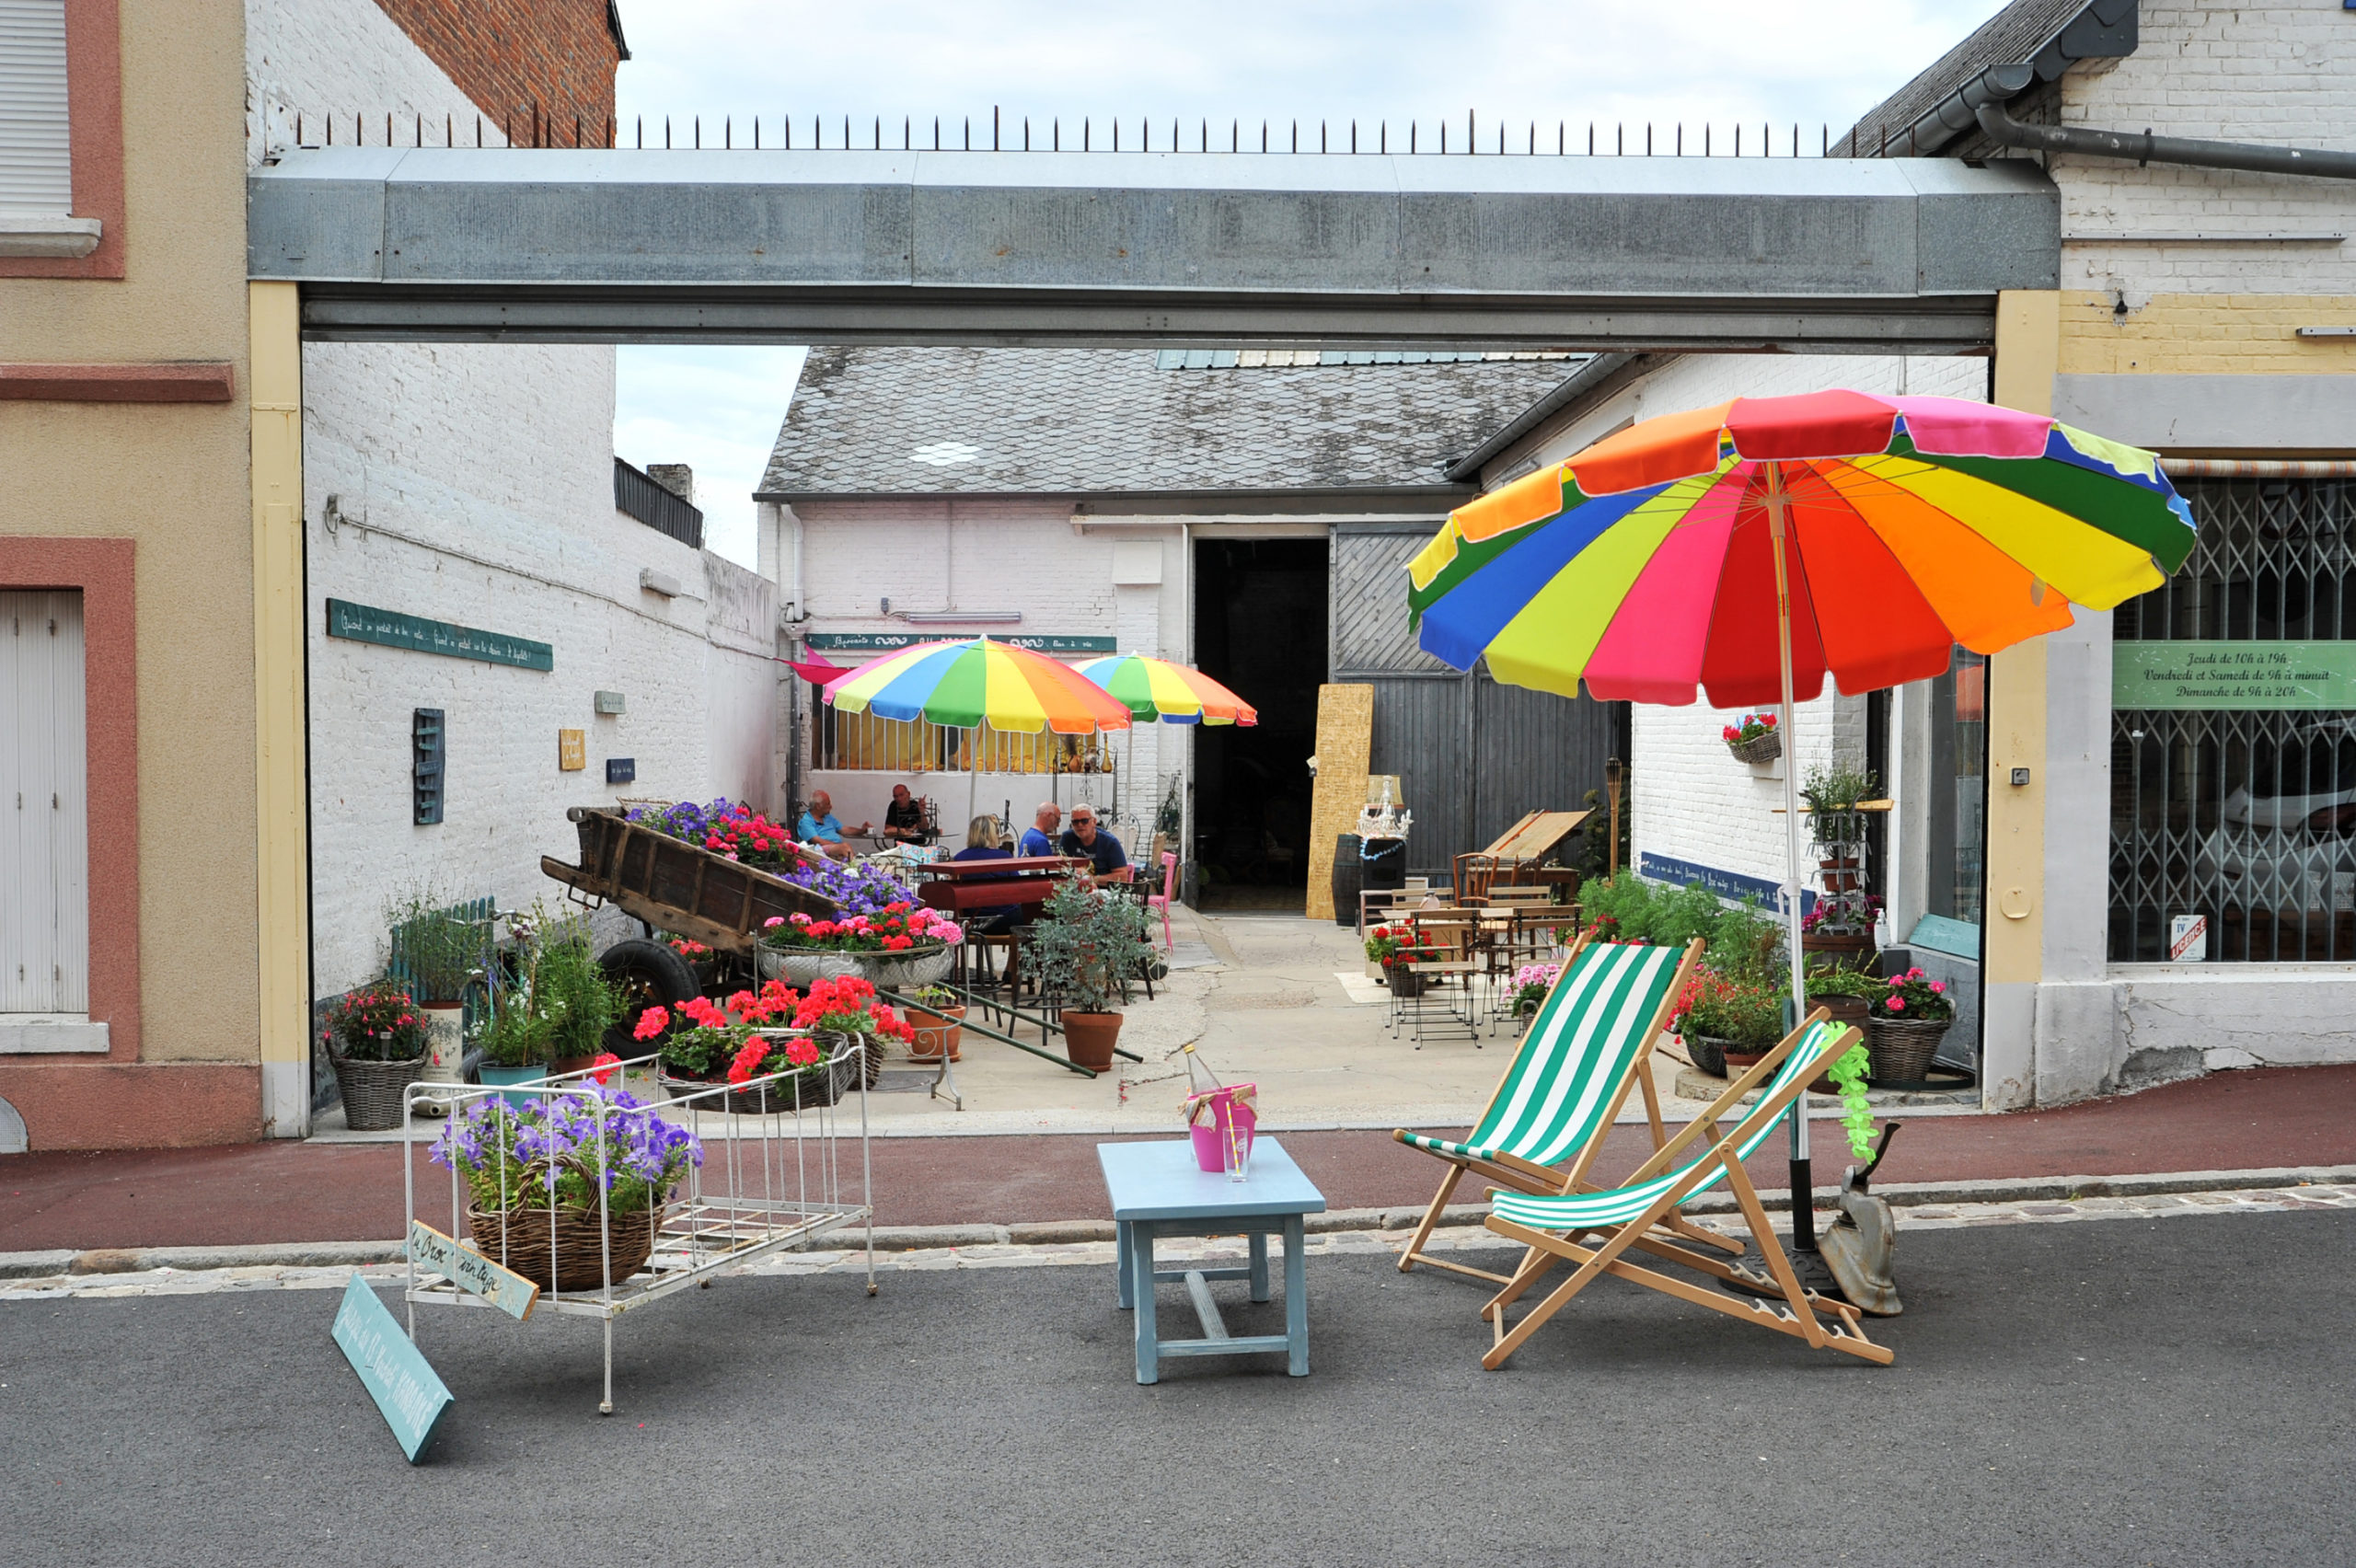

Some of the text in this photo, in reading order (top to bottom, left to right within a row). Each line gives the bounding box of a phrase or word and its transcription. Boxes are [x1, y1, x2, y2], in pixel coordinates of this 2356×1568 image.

[2187, 652, 2287, 666] Jeudi de 10h à 19h
[2143, 669, 2330, 681] Vendredi et Samedi de 9h à minuit
[2176, 686, 2296, 698] Dimanche de 9h à 20h
[2176, 923, 2186, 934] IV
[2171, 917, 2206, 961] LICENCE
